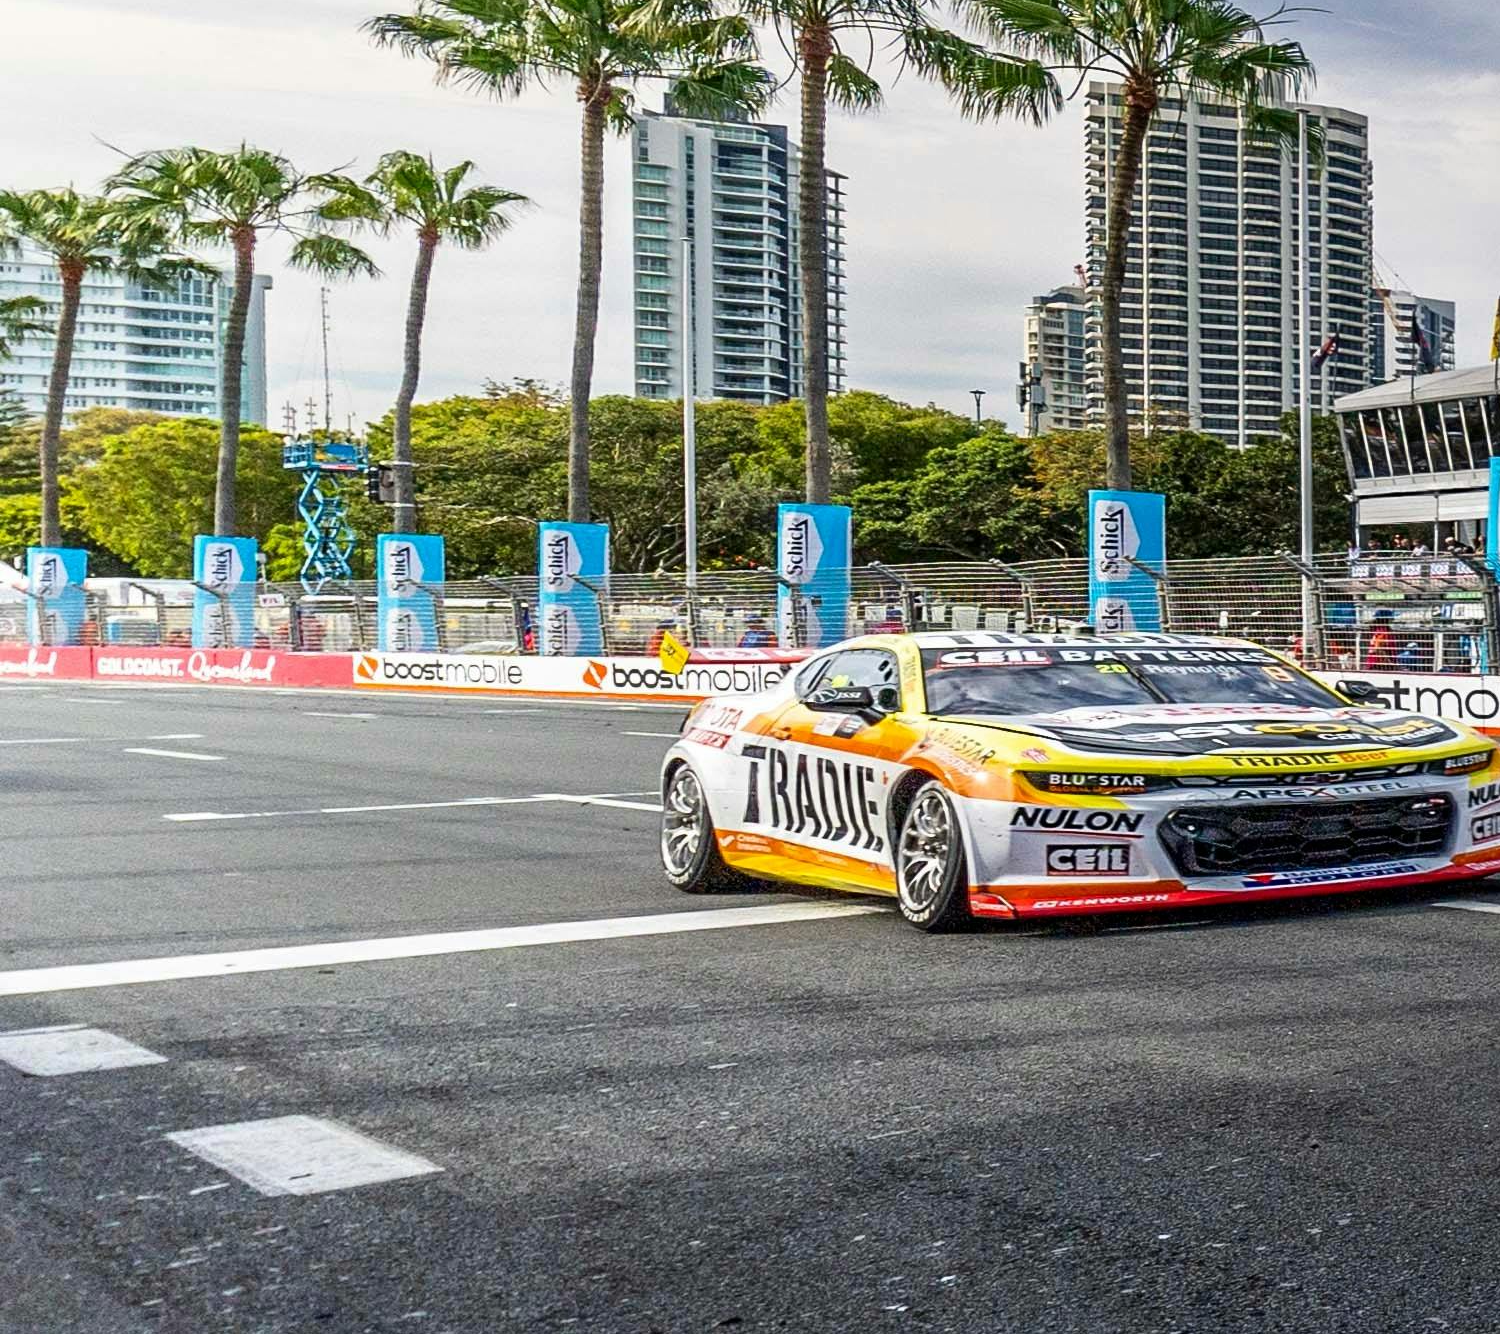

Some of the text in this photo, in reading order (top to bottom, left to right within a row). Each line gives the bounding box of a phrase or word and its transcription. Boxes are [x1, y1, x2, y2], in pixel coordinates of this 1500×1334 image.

[787, 519, 808, 576] Schick
[1099, 508, 1125, 575] Schick
[547, 535, 569, 587] Schick
[940, 649, 1280, 665] CEIL BATTERIES
[1095, 663, 1128, 674] 20
[1223, 750, 1390, 769] TRADIE Beer
[741, 742, 884, 854] TRADIE
[1232, 786, 1334, 800] APEX
[1009, 806, 1146, 832] NULON
[1049, 846, 1129, 872] CEIL
[1058, 893, 1170, 908] KENWORTH
